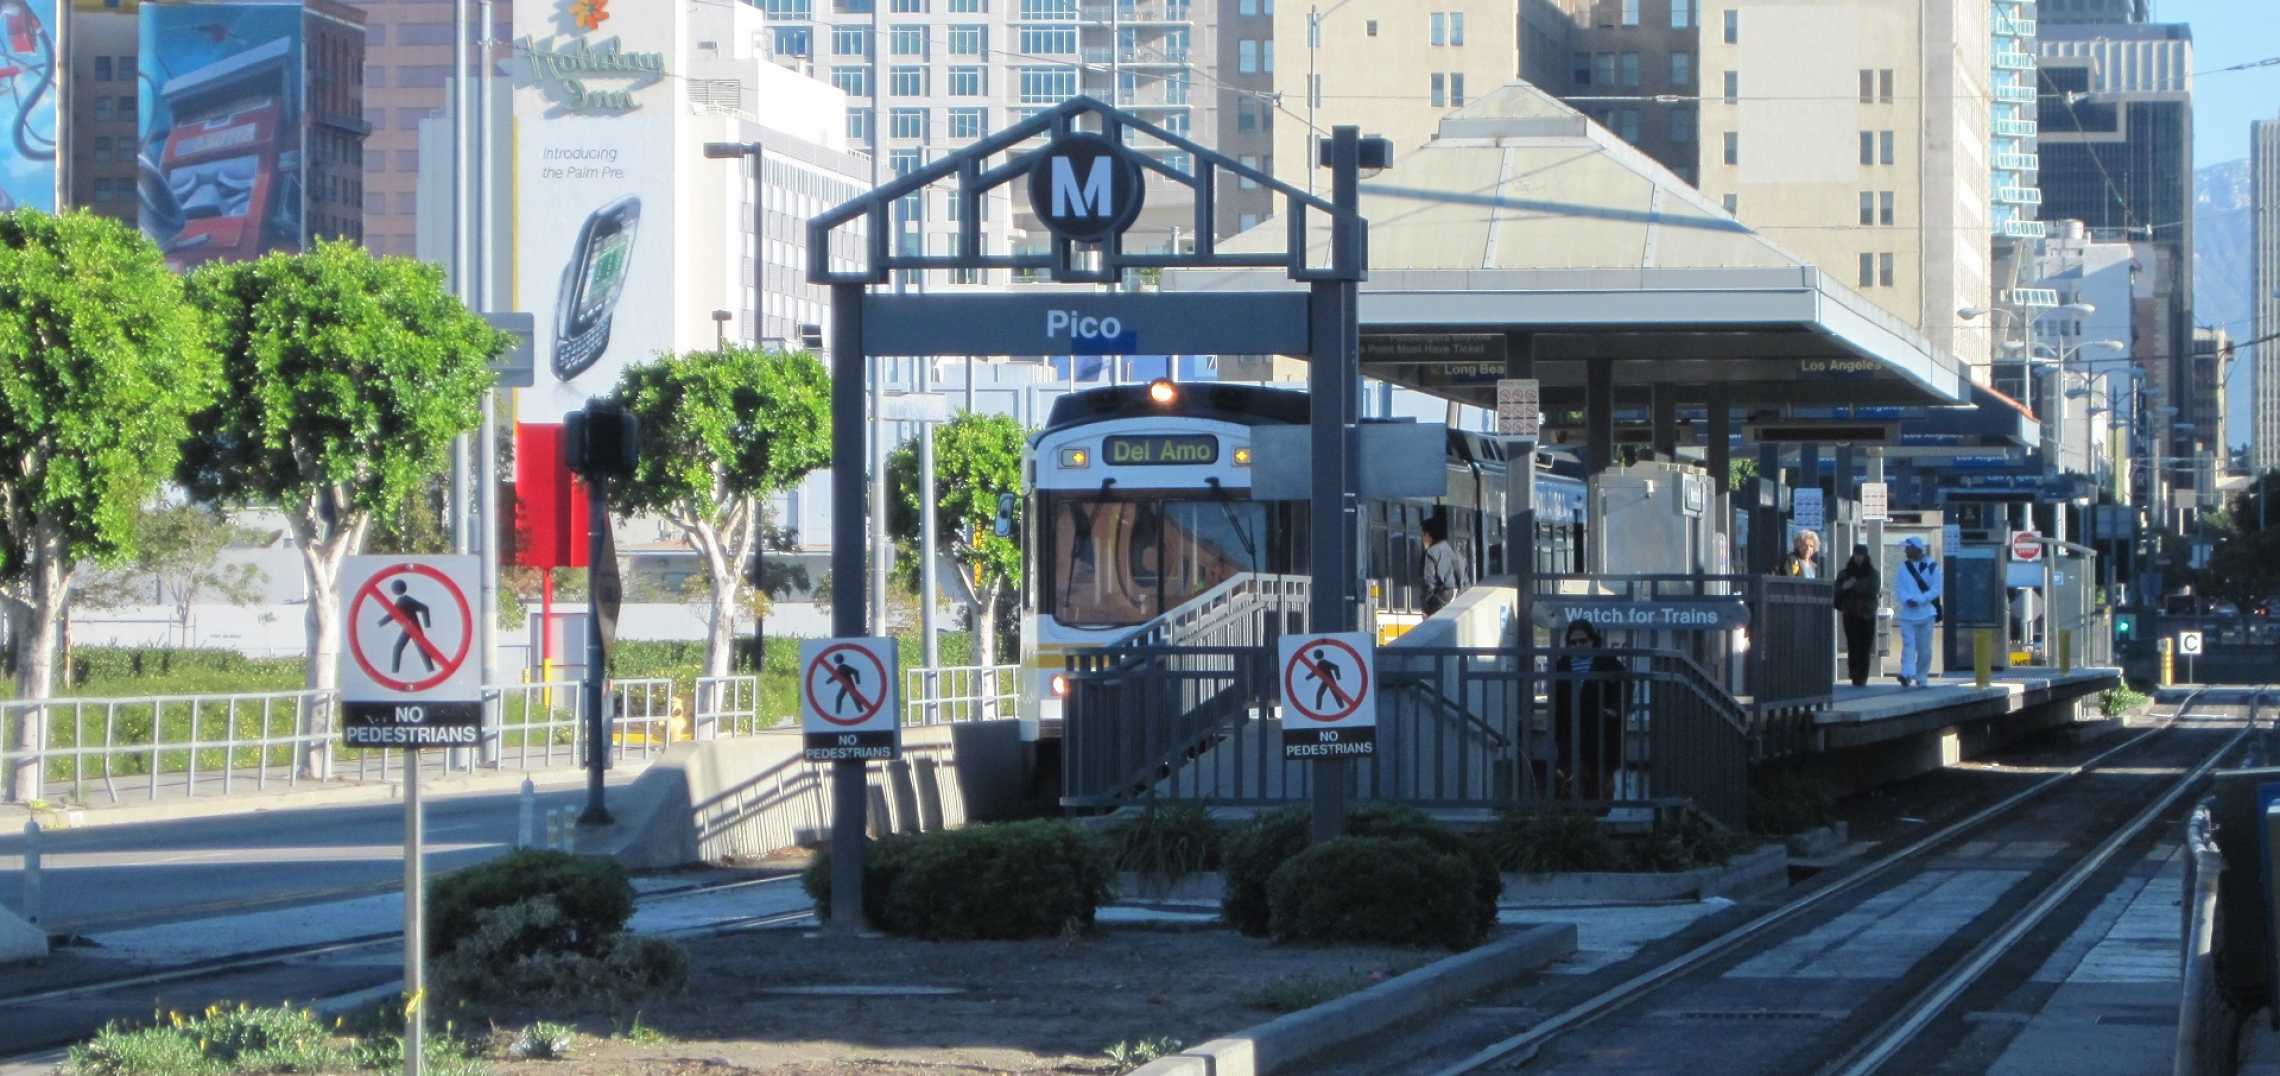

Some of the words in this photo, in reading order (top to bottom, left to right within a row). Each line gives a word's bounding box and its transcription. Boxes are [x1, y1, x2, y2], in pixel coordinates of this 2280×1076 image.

[543, 146, 618, 162] Introducing
[542, 167, 564, 179] the
[566, 167, 599, 179] Palm
[1051, 156, 1112, 217] M
[1046, 310, 1121, 339] Pico
[1454, 343, 1485, 353] Ticket
[1444, 363, 1476, 375] Long
[1479, 363, 1505, 375] Bea
[1801, 359, 1826, 371] Los
[1829, 359, 1882, 373] Angeles
[1114, 440, 1149, 462] Del
[1159, 440, 1211, 460] Amo
[1564, 607, 1624, 624] Watch
[1627, 607, 1655, 624] for
[1660, 607, 1719, 624] Trains
[2184, 634, 2198, 651] C
[395, 706, 424, 723] NO
[346, 725, 477, 743] PEDESTRIANS
[838, 734, 857, 746] NO
[1319, 730, 1339, 742] NO
[806, 746, 891, 760] PEDESTRIANS
[1285, 741, 1374, 757] PEDESTRIANS
